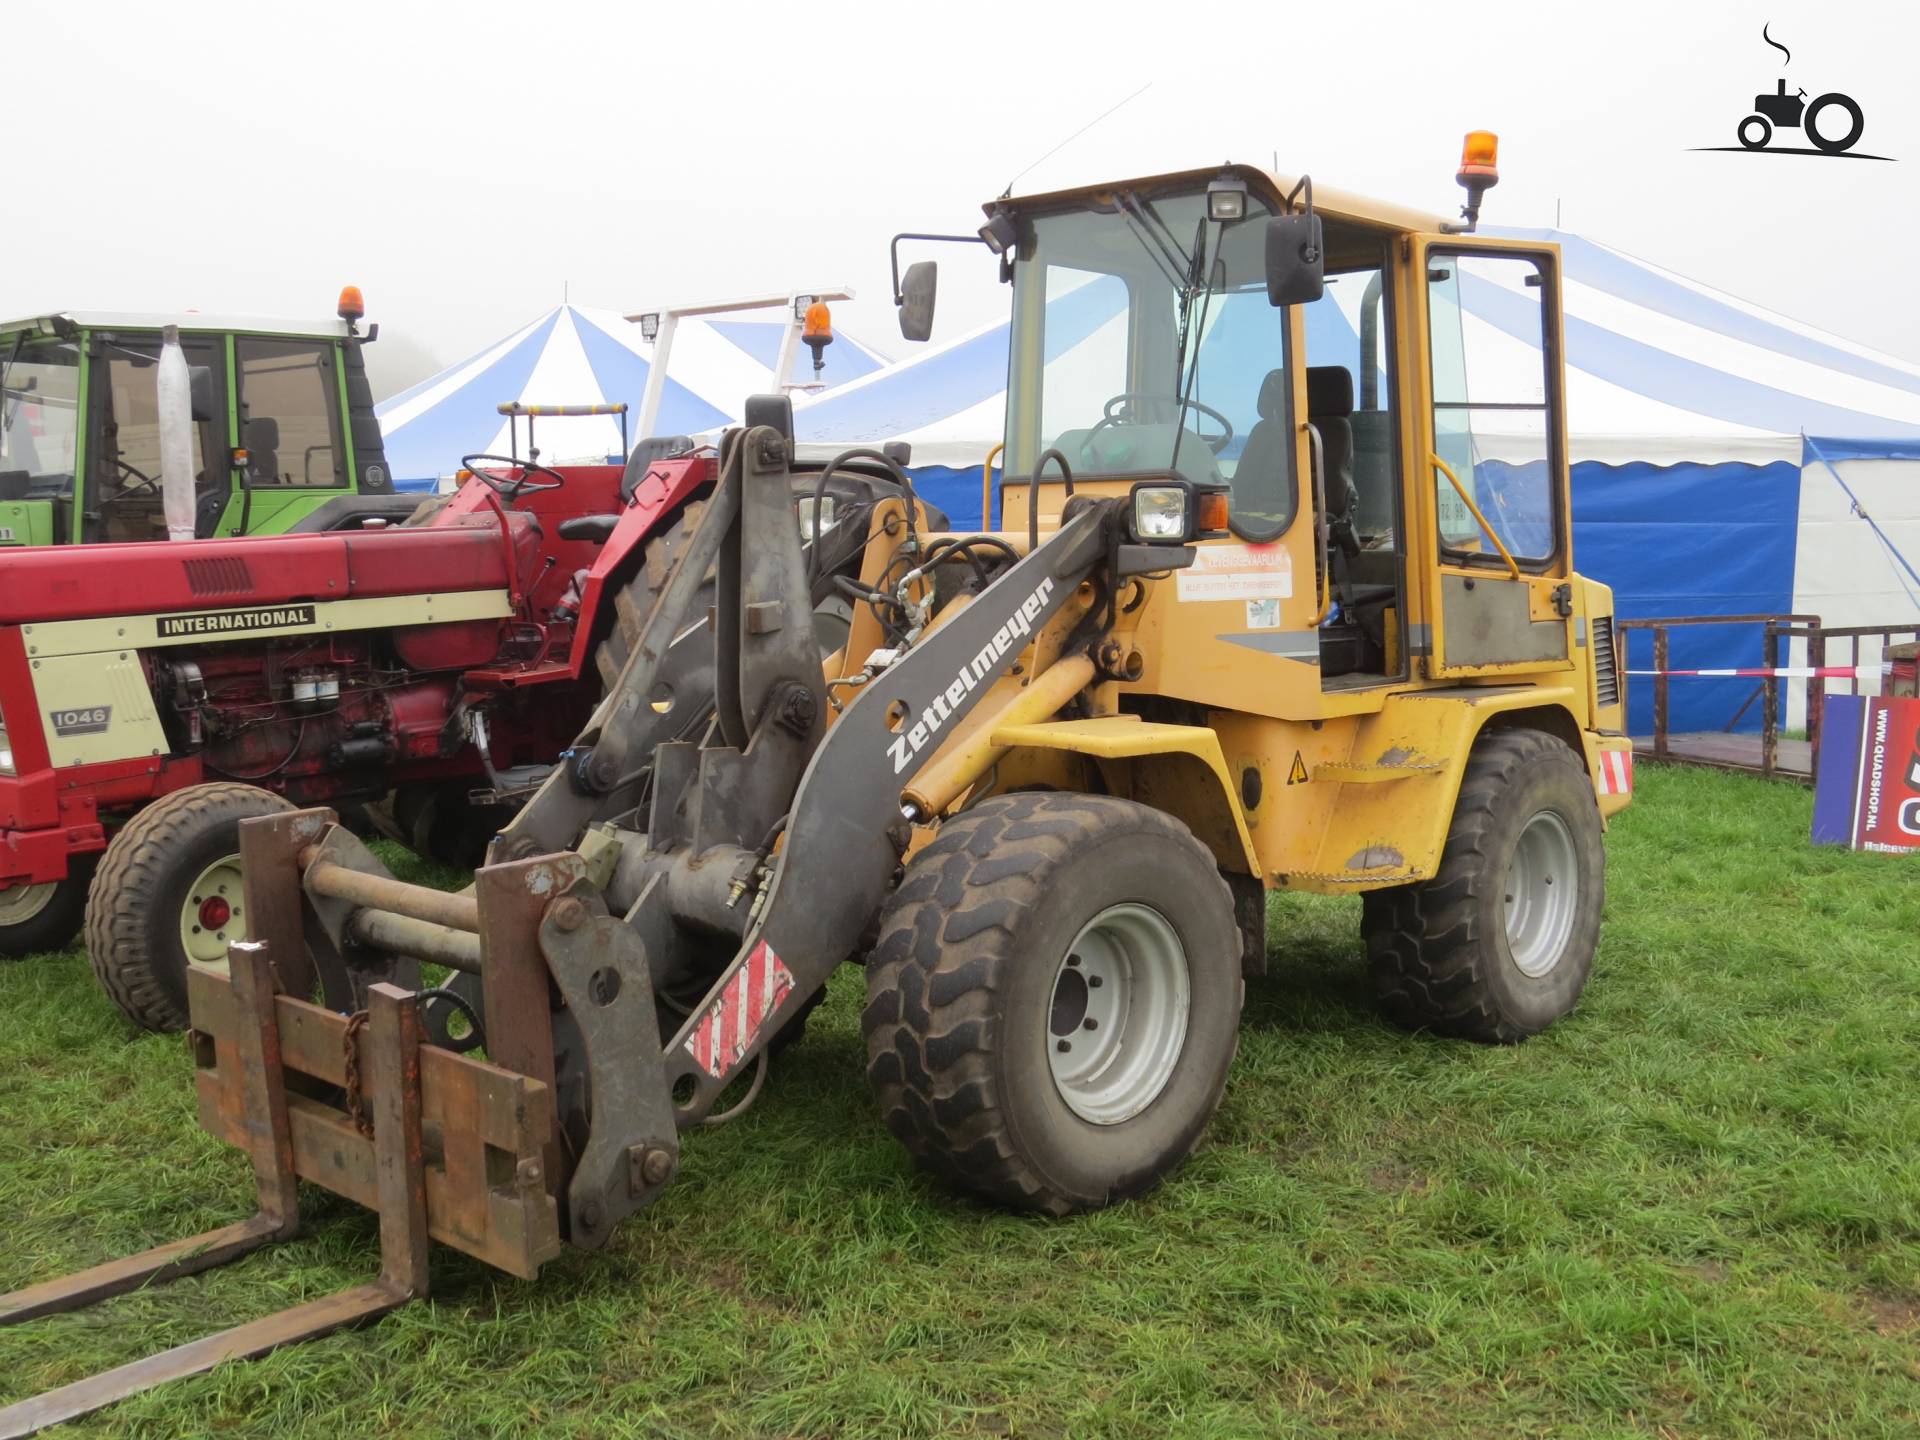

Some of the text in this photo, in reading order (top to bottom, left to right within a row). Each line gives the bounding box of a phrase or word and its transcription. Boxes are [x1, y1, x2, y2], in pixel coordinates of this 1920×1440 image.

[164, 609, 308, 634] INTERNATIONAL
[886, 576, 1054, 774] Zettelmeyer
[57, 709, 106, 726] 1046
[1865, 709, 1888, 831] WWW.QUADSHOP.NL
